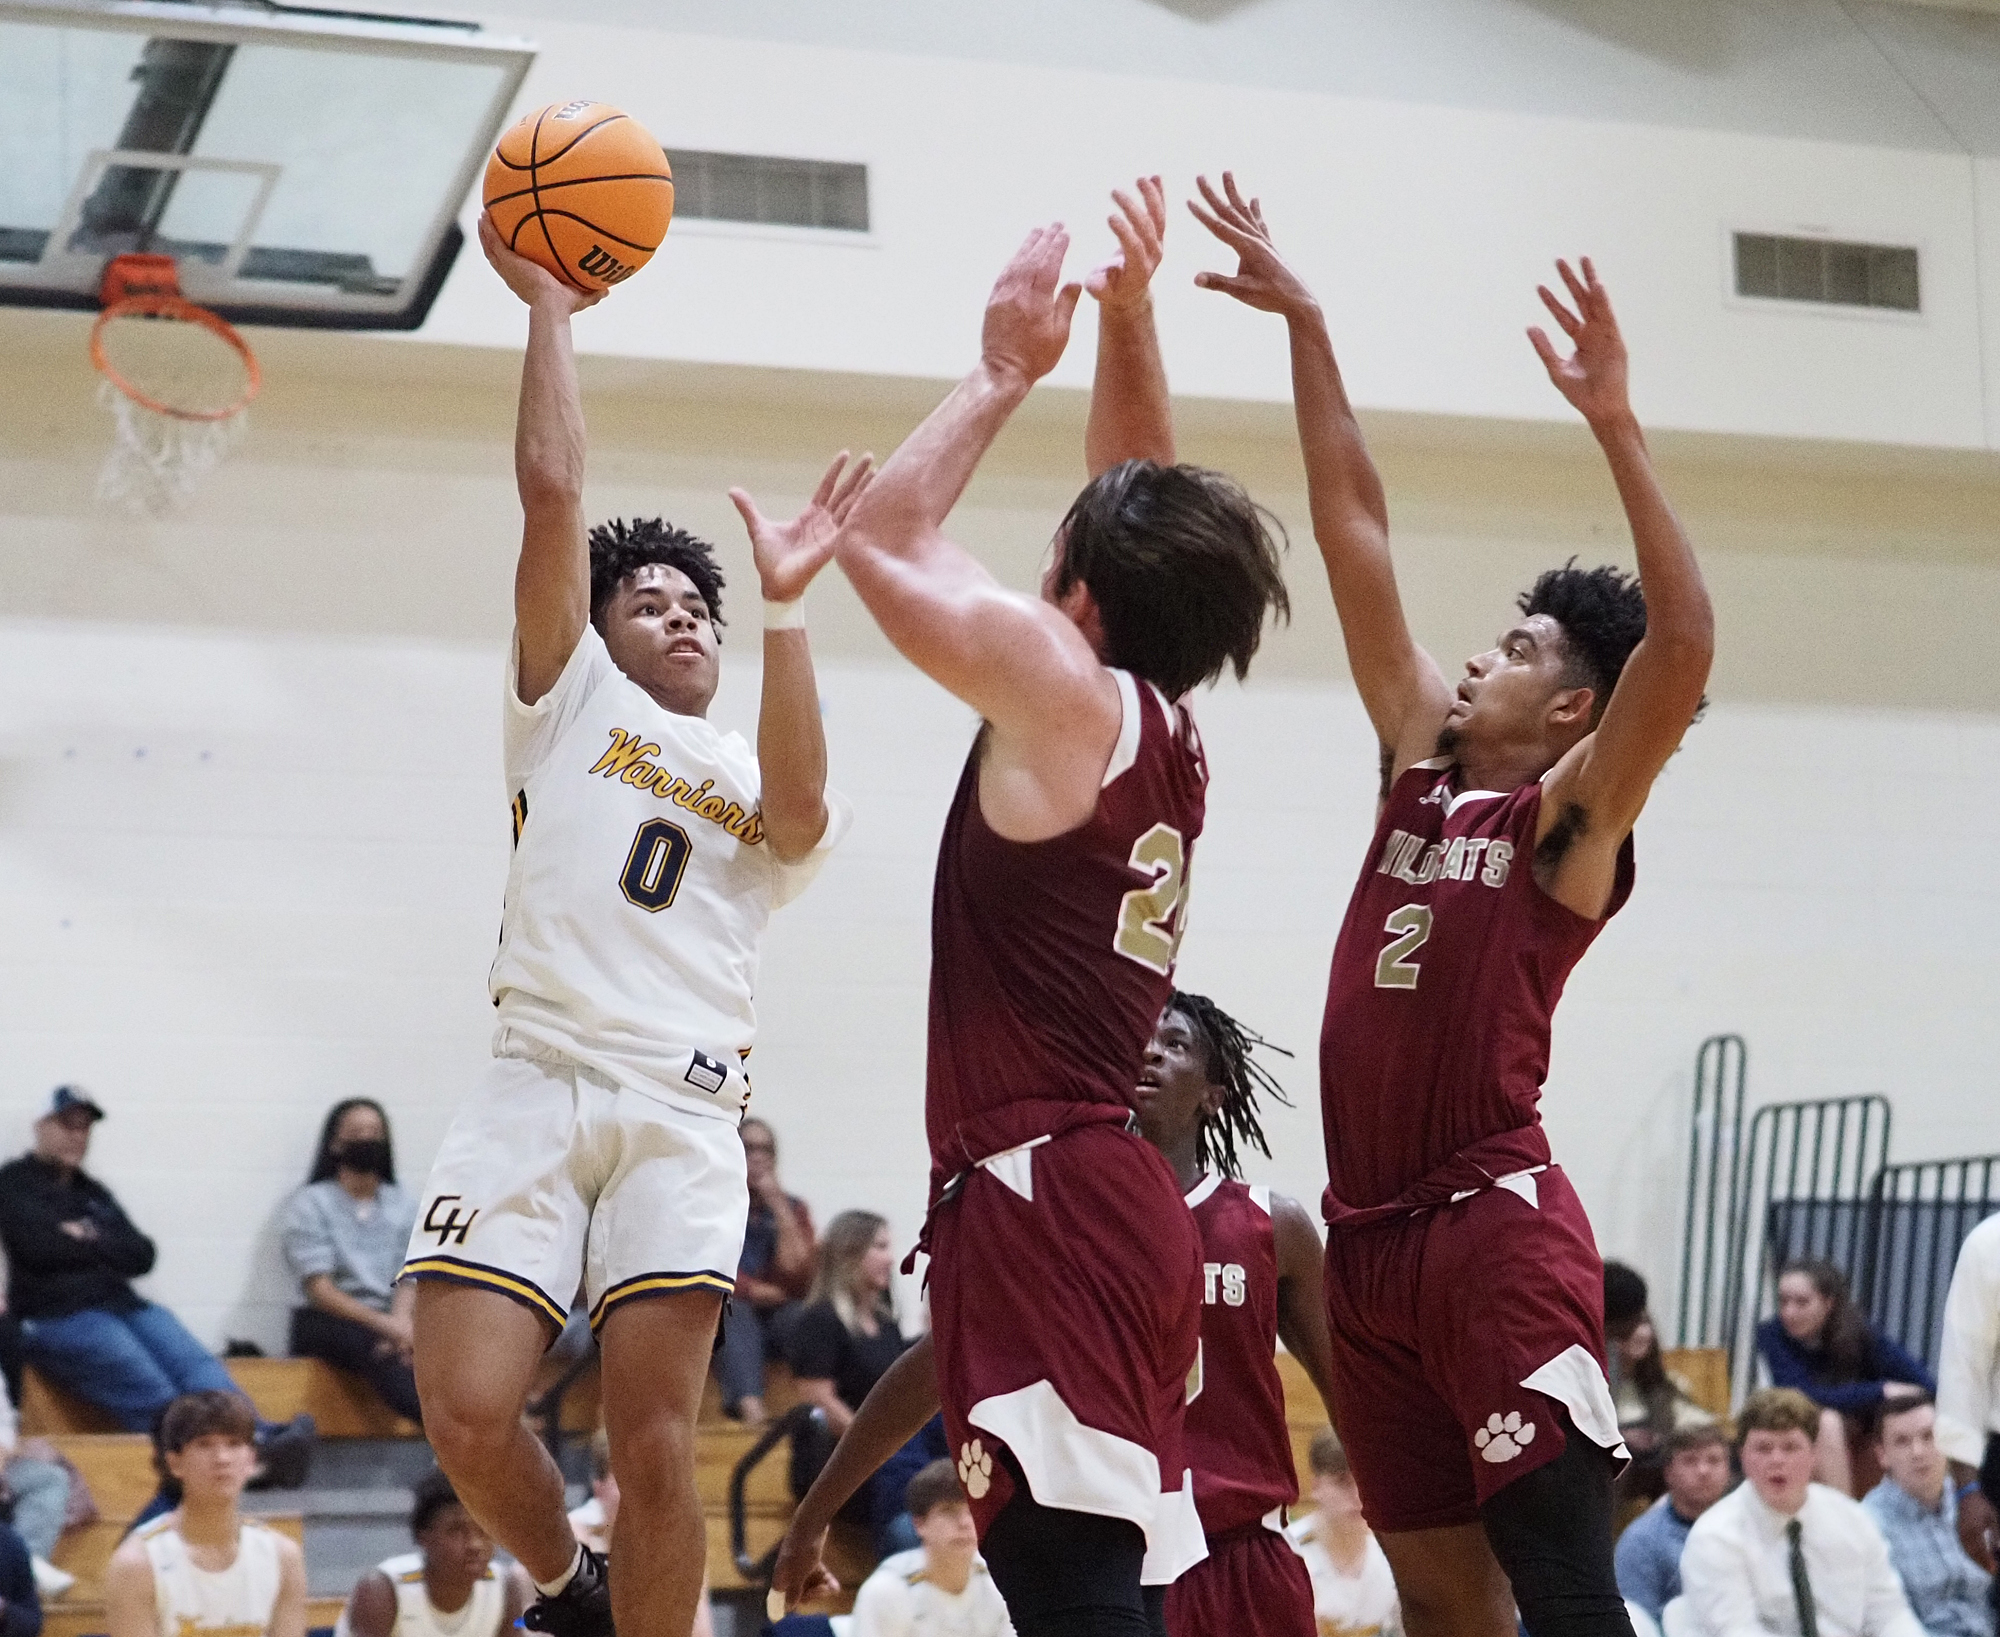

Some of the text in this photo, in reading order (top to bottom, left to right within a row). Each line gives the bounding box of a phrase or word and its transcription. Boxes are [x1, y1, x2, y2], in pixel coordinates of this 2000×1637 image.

[588, 727, 765, 845] Warriors
[618, 817, 693, 914] 0
[1374, 903, 1434, 990] 2
[1200, 1262, 1246, 1307] TS
